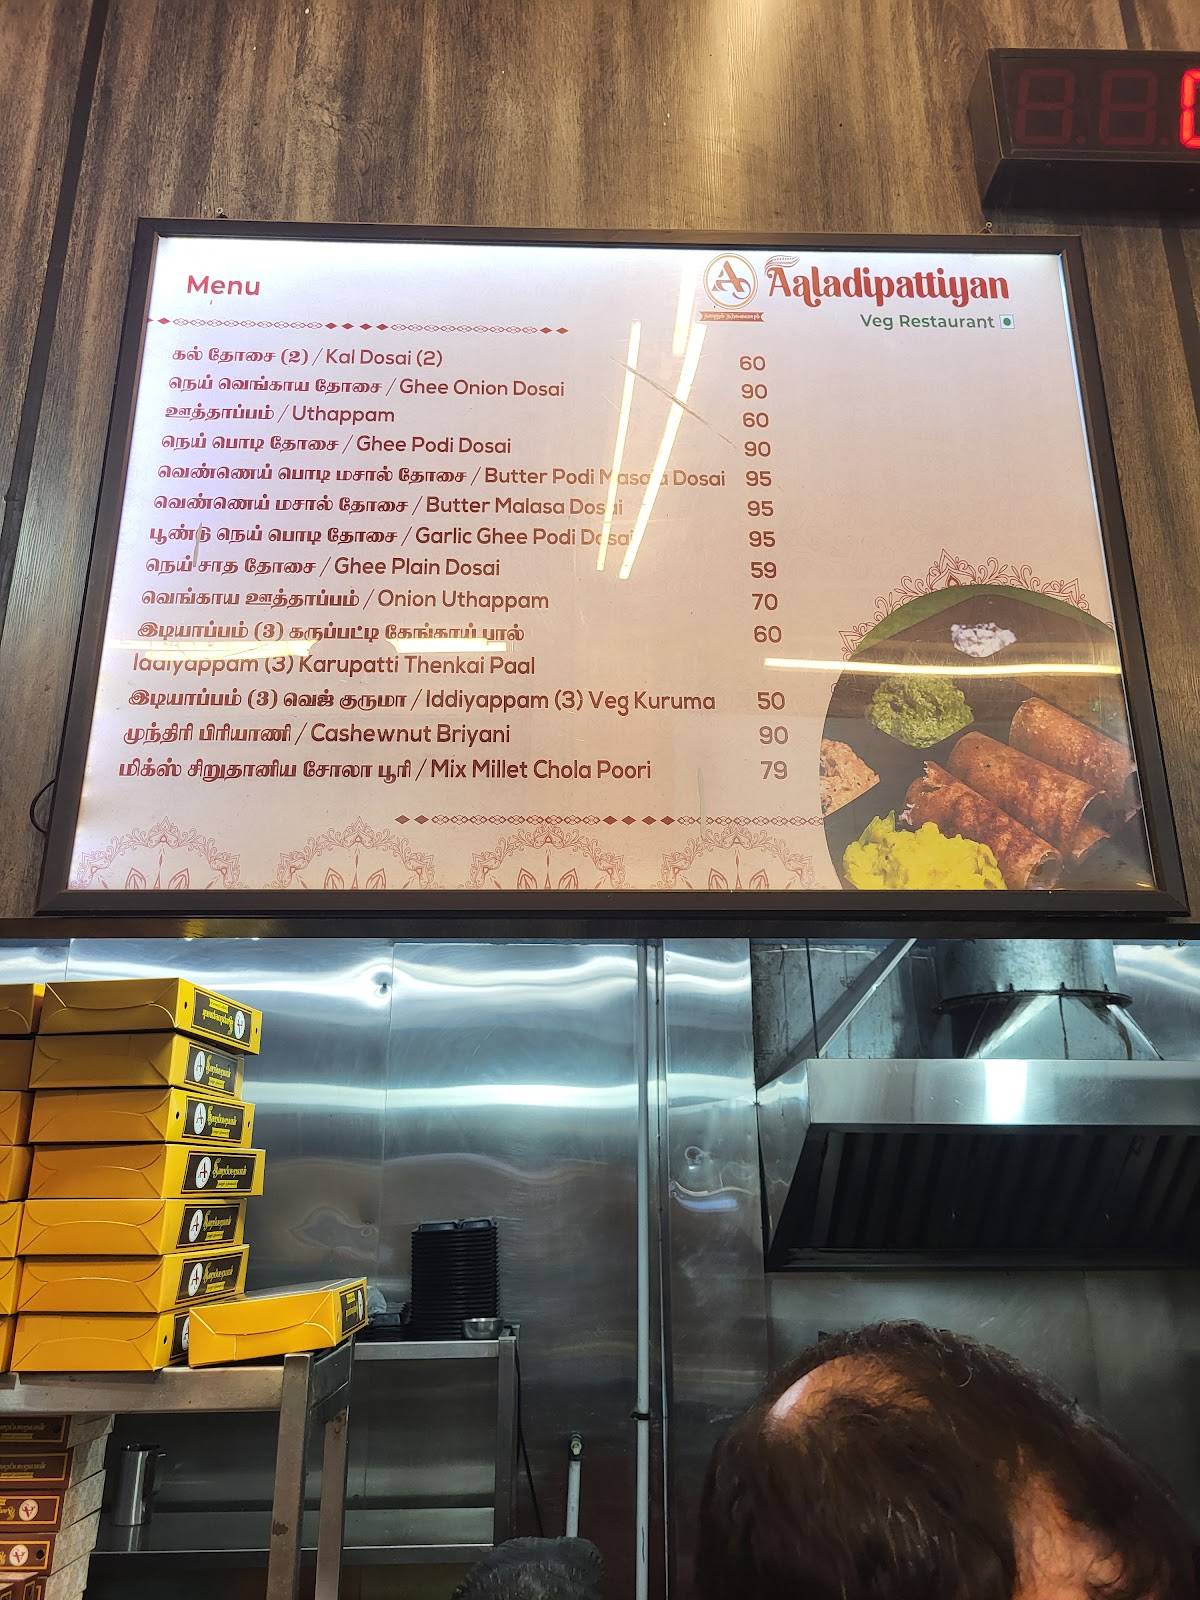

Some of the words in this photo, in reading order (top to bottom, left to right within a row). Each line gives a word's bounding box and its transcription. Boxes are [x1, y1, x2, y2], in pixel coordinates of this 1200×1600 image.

[187, 275, 260, 296] Menu
[766, 262, 1009, 307] Aaladipattiyan
[860, 314, 893, 330] Veg
[899, 315, 995, 328] Restaurant
[172, 346, 203, 360] கல்
[209, 348, 276, 364] தோசை
[281, 349, 308, 365] (2)
[326, 349, 355, 364] Kal
[360, 349, 411, 365] Dosai
[417, 350, 442, 368] (2)
[740, 356, 765, 371] 60
[169, 374, 213, 392] நெய்
[218, 376, 309, 391] வெங்காய
[315, 379, 382, 395] தோசை
[400, 378, 448, 394] Ghee
[454, 379, 508, 395] Onion
[513, 380, 564, 396] Dosai
[742, 384, 767, 399] 90
[165, 403, 274, 421] ஊத்தாப்பம்
[293, 405, 394, 425] Uthappam
[743, 412, 768, 428] 60
[162, 432, 206, 451] நெய்
[212, 436, 264, 452] பொடி
[270, 436, 339, 453] தோசை
[357, 435, 406, 451] Ghee
[412, 436, 453, 452] Podi
[459, 437, 511, 453] Dosai
[745, 441, 771, 457] 90
[158, 463, 272, 479] வெண்ணெய்
[278, 467, 330, 483] பொடி
[336, 466, 393, 481] மசால்
[399, 468, 467, 485] தோசை
[485, 467, 548, 483] Butter
[553, 468, 594, 484] Podi
[600, 469, 668, 486] Masaa
[674, 470, 725, 486] Dosai
[746, 471, 771, 486] 95
[154, 493, 270, 510] வெண்ணெய்
[275, 495, 333, 511] மசால்
[339, 497, 408, 515] தோசை
[427, 496, 490, 513] Butter
[495, 497, 564, 514] Malasa
[748, 501, 773, 516] 95
[217, 525, 262, 544] நெய்
[268, 529, 321, 545] பொடி
[327, 528, 398, 545] தோசை
[416, 527, 472, 544] Garlic
[477, 527, 527, 544] Ghee
[534, 528, 575, 545] Podi
[749, 531, 775, 547] 95
[146, 555, 193, 575] நெய்
[198, 561, 238, 576] சாத
[245, 558, 316, 576] தோசை
[335, 557, 386, 574] Ghee
[392, 558, 440, 575] Plain
[446, 559, 500, 576] Dosai
[751, 562, 776, 578] 59
[142, 587, 240, 604] வெங்காய
[245, 588, 359, 609] ஊத்தாப்பம்
[378, 589, 436, 607] Onion
[442, 590, 548, 612] Uthappam
[752, 593, 778, 610] 70
[137, 621, 248, 640] இடியாப்பம்
[254, 622, 283, 640] (3)
[289, 622, 379, 642] கருப்பட்டி
[482, 624, 524, 641] பால்
[754, 626, 781, 643] 60
[265, 656, 293, 674] (3)
[300, 655, 398, 677] Karupatti
[404, 656, 484, 673] Thenkai
[490, 656, 534, 674] Paal
[128, 688, 242, 709] இடியாப்பம்
[248, 689, 278, 709] (3)
[284, 689, 334, 707] வெஜ்
[340, 695, 407, 711] குருமா
[426, 690, 548, 713] Iddiyappam
[555, 689, 583, 711] (3)
[588, 691, 629, 716] Veg
[635, 691, 715, 709] Kuruma
[758, 692, 785, 710] 50
[124, 722, 193, 745] முந்திரி
[199, 723, 291, 741] பிரியாணி
[311, 723, 431, 742] Cashewnut
[437, 724, 510, 747] Briyani
[760, 726, 788, 744] 90
[119, 757, 182, 776] மிக்ஸ்
[188, 759, 296, 782] சிறுதானிய
[303, 761, 373, 778] சோலா
[378, 759, 411, 784] பூரி
[431, 759, 466, 778] Mix
[472, 760, 528, 778] Millet
[534, 760, 591, 778] Chola
[597, 760, 650, 778] Poori
[761, 761, 787, 779] 79
